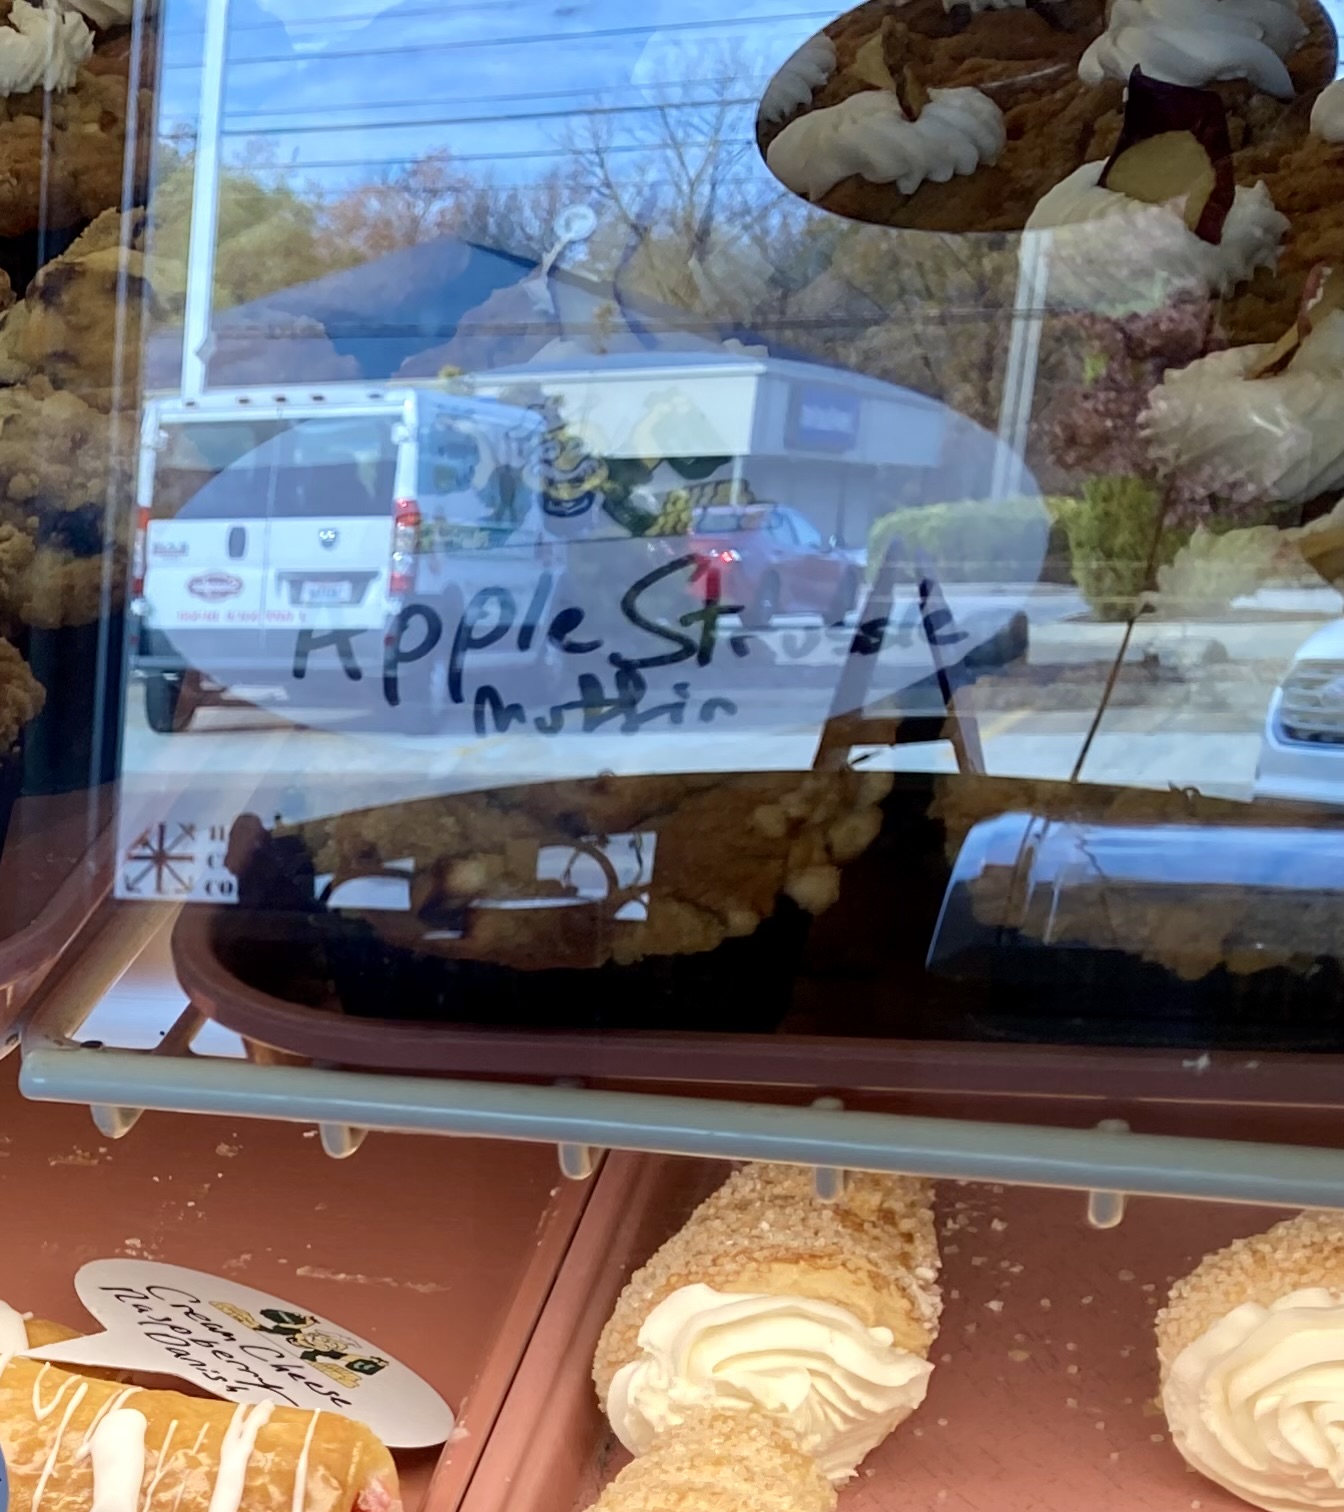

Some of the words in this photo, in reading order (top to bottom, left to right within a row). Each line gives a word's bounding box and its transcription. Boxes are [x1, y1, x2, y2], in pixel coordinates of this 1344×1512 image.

[293, 574, 603, 705] Apple
[97, 1285, 300, 1408] Raspberry
[143, 1330, 250, 1394] Danish
[145, 1284, 237, 1353] Cream
[238, 1343, 353, 1408] Cheese
